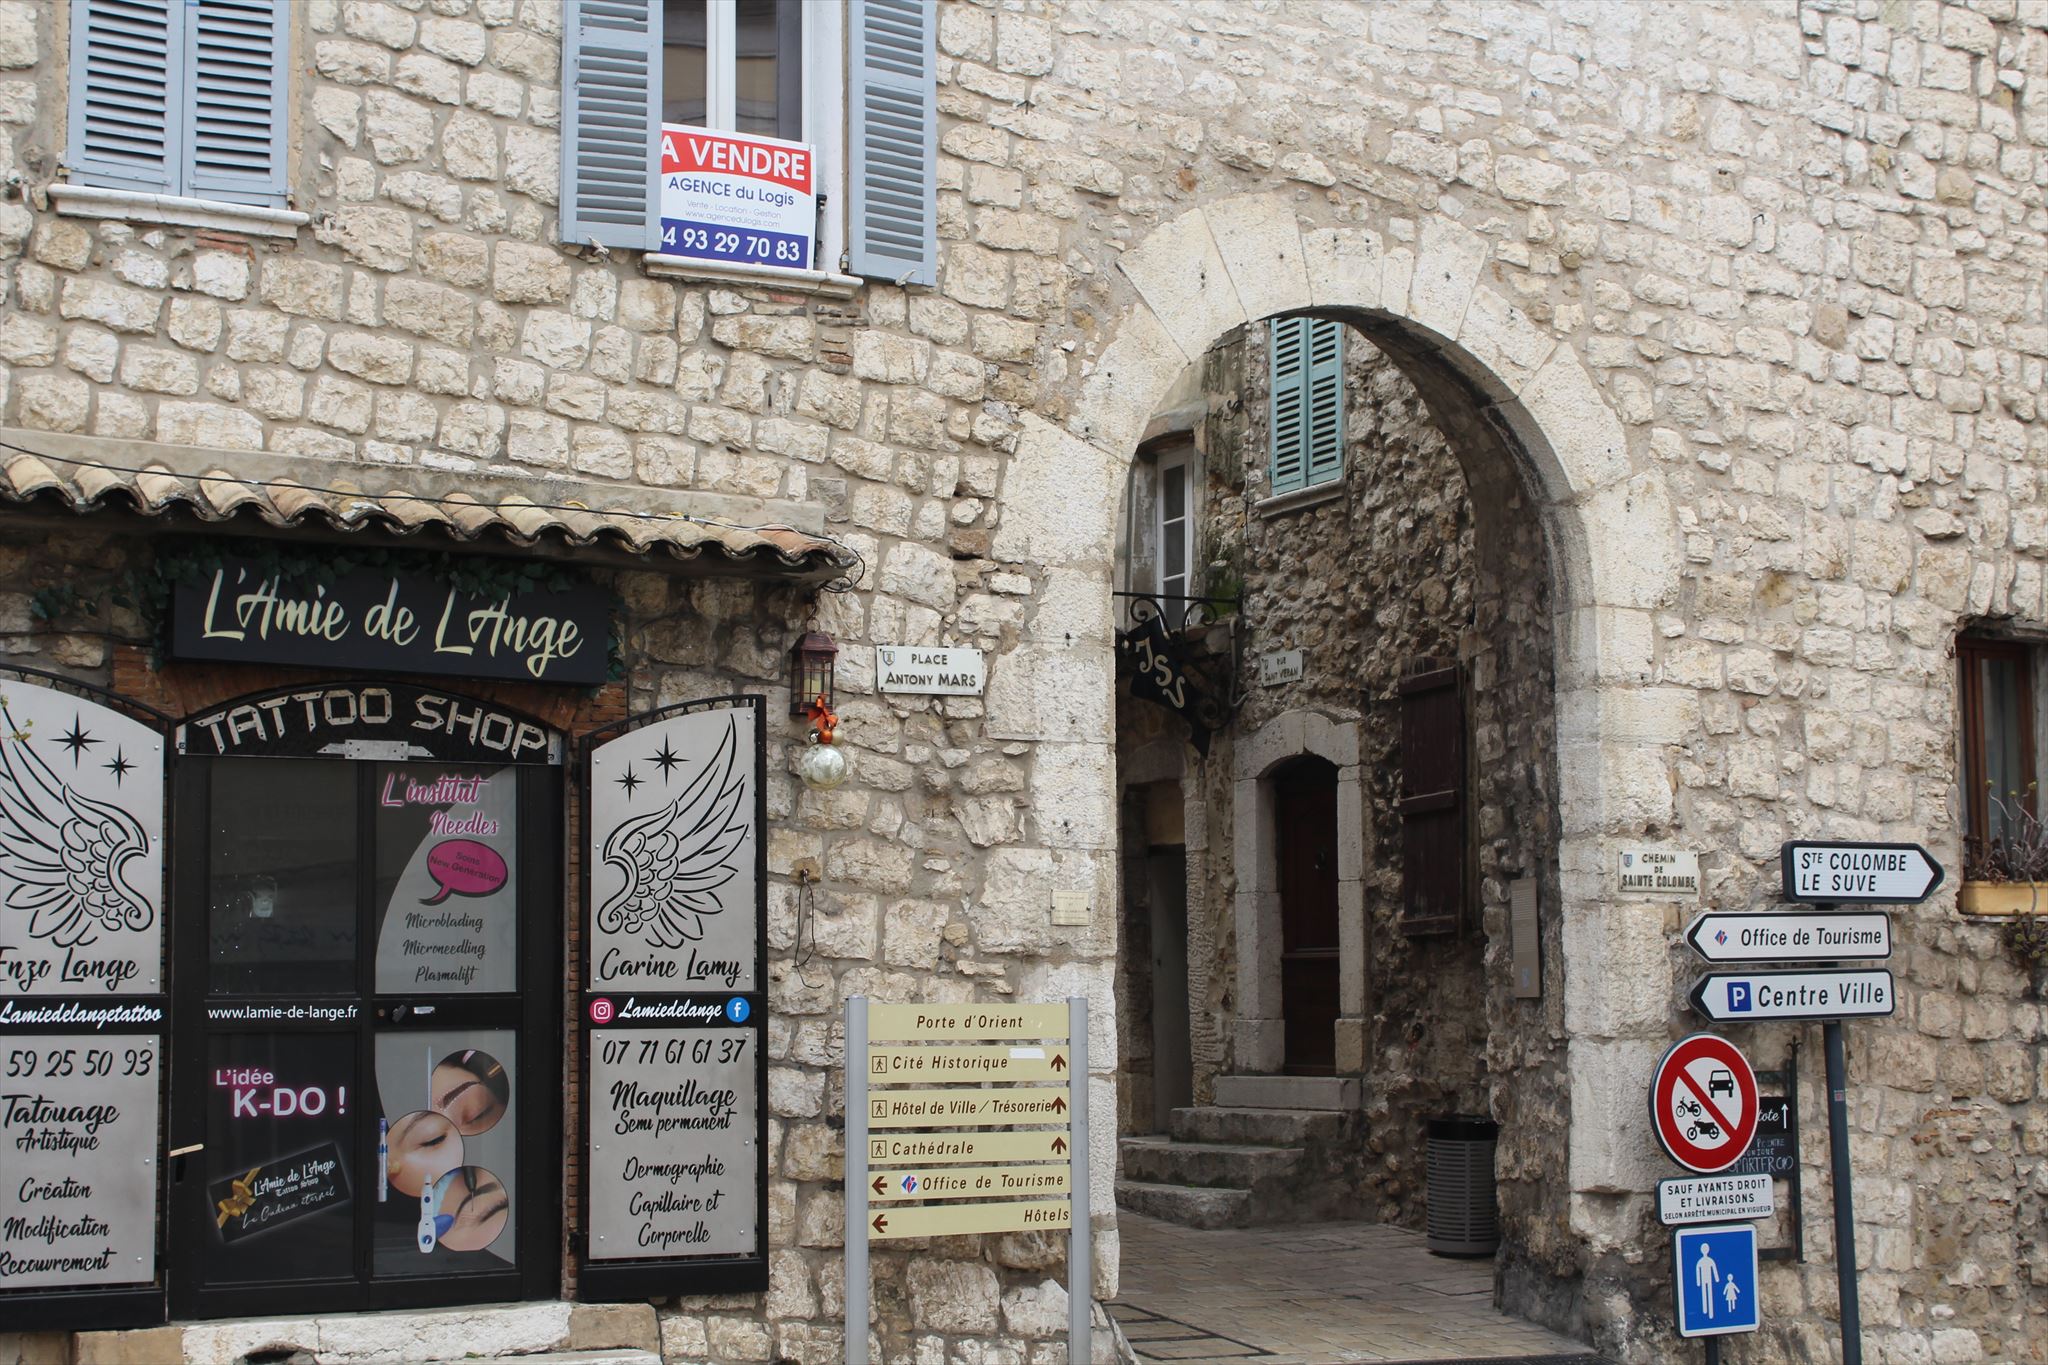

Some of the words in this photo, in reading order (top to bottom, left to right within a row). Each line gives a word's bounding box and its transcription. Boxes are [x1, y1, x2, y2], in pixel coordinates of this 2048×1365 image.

[661, 134, 680, 163] A
[688, 137, 806, 181] VENDRE
[668, 176, 731, 197] AGENCE
[735, 186, 754, 200] du
[758, 188, 794, 207] Logis
[687, 199, 709, 210] Vente
[715, 204, 748, 215] Location
[753, 208, 782, 219] Gestion
[683, 227, 708, 250] 93
[714, 232, 740, 254] 29
[746, 236, 771, 258] 70
[775, 240, 801, 262] 83
[202, 567, 351, 642] L'Amie
[364, 576, 421, 646] de
[911, 653, 948, 666] PLACE
[938, 673, 977, 688] MARS
[194, 687, 392, 756] TATTOO
[411, 693, 547, 760] SHOP
[382, 772, 490, 807] L'institut
[431, 810, 500, 836] Needles
[1641, 853, 1676, 864] CHEMIN
[1830, 853, 1907, 871] COLOMBE
[1622, 874, 1653, 887] SAINTE
[1656, 875, 1695, 888] COLOMBE
[1802, 873, 1820, 891] LE
[1831, 874, 1877, 892] SUVE
[405, 912, 484, 933] Microblading
[402, 939, 486, 960] Microneedling
[1740, 929, 1787, 947] Office
[1793, 927, 1810, 945] de
[1816, 926, 1882, 944] Tourisme
[60, 947, 140, 991] Lange
[415, 965, 480, 985] Plasmalift
[600, 947, 680, 981] Carine
[686, 948, 742, 988] Lamy
[1758, 984, 1828, 1007] Centre
[1838, 981, 1884, 1003] Ville
[0, 1000, 162, 1030] Lamiedelangetattoo
[208, 1005, 358, 1021] www.lamie-de-lange.fr
[618, 997, 722, 1023] Lamiedelange
[916, 1015, 955, 1029] Porte
[964, 1015, 1023, 1028] d'Orient
[6, 1050, 38, 1077] 59
[44, 1050, 76, 1077] 25
[83, 1050, 114, 1077] 50
[122, 1050, 153, 1077] 93
[602, 1039, 630, 1064] 07
[638, 1039, 659, 1064] 71
[665, 1039, 685, 1064] 61
[692, 1039, 713, 1064] 61
[717, 1039, 747, 1063] 37
[893, 1056, 923, 1069] Cité
[932, 1056, 1008, 1070] Historique
[215, 1069, 275, 1087] L'idée
[233, 1087, 327, 1118] K-DO
[610, 1079, 738, 1116] Maquillage
[892, 1100, 926, 1115] Hôtel
[930, 1099, 945, 1115] de
[950, 1098, 977, 1114] Ville
[993, 1098, 1051, 1113] Trésorerie
[1, 1094, 120, 1135] Tatouage
[615, 1109, 652, 1135] Semi
[655, 1107, 737, 1138] permanent
[16, 1127, 100, 1158] Artistique
[892, 1143, 974, 1155] Cathédrale
[254, 1176, 286, 1196] L'Amie
[287, 1168, 300, 1182] de
[303, 1160, 336, 1180] L'Ange
[622, 1154, 726, 1185] Dermographie
[922, 1176, 967, 1190] Office
[975, 1175, 992, 1188] de
[1001, 1173, 1064, 1188] Tourisme
[19, 1176, 93, 1203] Création
[1668, 1184, 1693, 1195] SAUF
[1698, 1181, 1734, 1193] AYANTS
[1738, 1179, 1766, 1190] DROIT
[629, 1191, 702, 1220] Capillaire
[706, 1189, 726, 1211] et
[1681, 1198, 1692, 1208] ET
[1696, 1193, 1755, 1207] LIVRAISONS
[1706, 1207, 1737, 1216] MUNICIPAL
[1747, 1205, 1771, 1213] VIGUEUR
[1024, 1207, 1070, 1222] Hôtels
[3, 1214, 110, 1245] Modification
[638, 1220, 711, 1250] Corporelle
